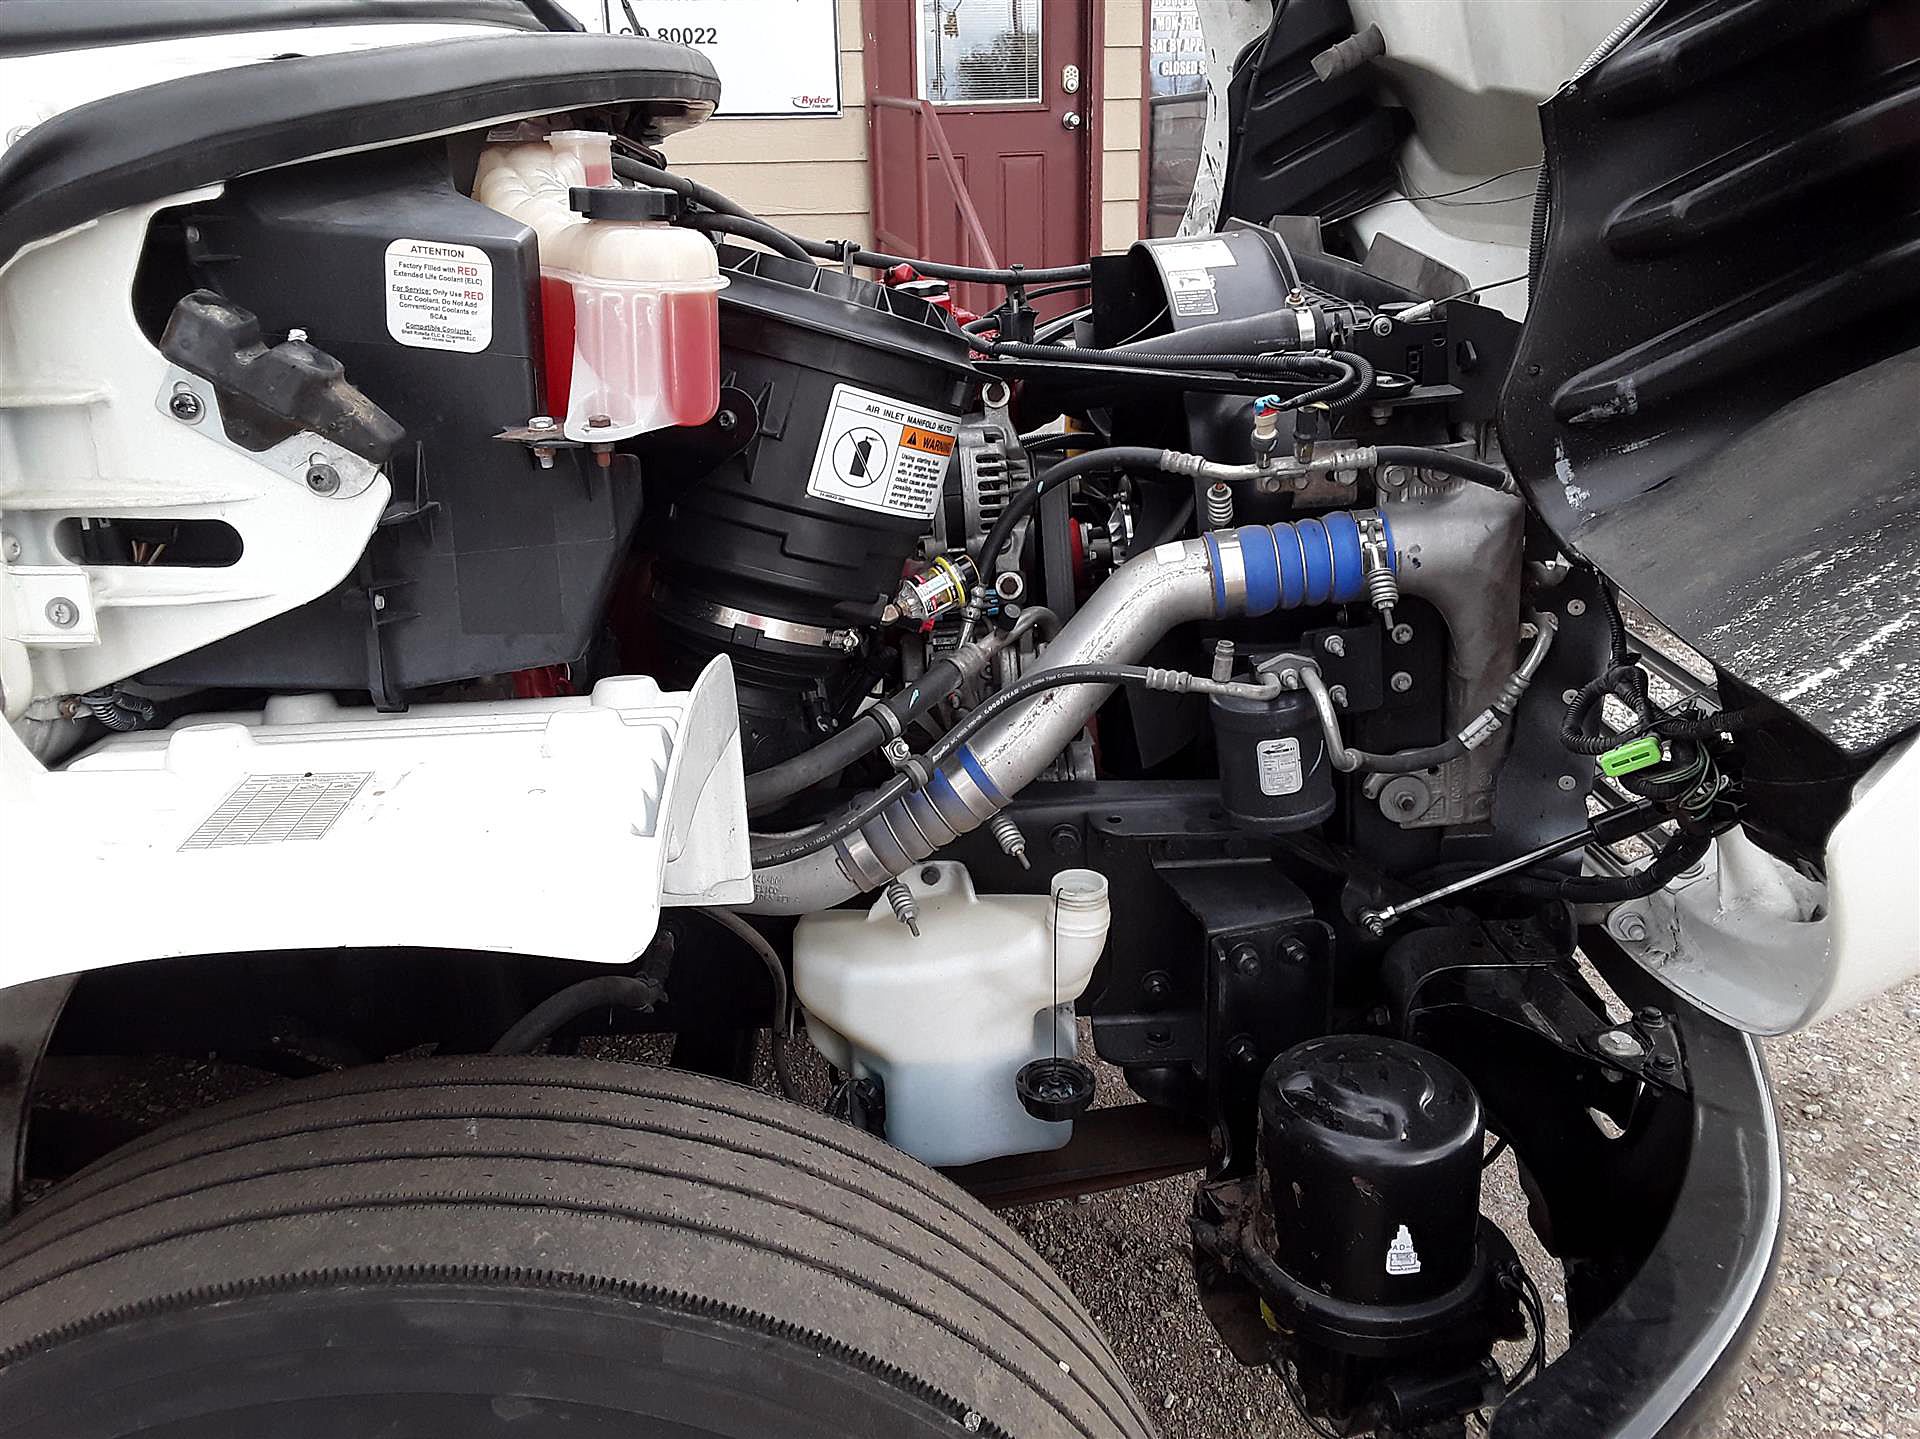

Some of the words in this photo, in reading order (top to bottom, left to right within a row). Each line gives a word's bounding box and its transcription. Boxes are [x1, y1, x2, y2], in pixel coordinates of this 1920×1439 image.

[658, 28, 718, 45] 80022
[1150, 39, 1169, 52] SAT
[1160, 61, 1198, 75] CLOSED
[802, 95, 831, 105] Ryder
[410, 245, 464, 258] ATTENTION
[399, 261, 422, 271] Factory
[424, 264, 441, 272] Filled
[457, 266, 478, 277] RED
[393, 270, 423, 279] Extended
[439, 275, 463, 283] Coolant
[465, 277, 482, 286] (ELC)
[432, 289, 447, 297] Only
[464, 290, 484, 301] RED
[399, 302, 440, 311] Conventional
[442, 306, 469, 314] Coolants
[865, 405, 881, 415] AIR
[883, 409, 904, 421] INLET
[906, 415, 937, 430] MANIFOLD
[922, 436, 952, 453] WARN
[984, 688, 1019, 715] GOODYEAR
